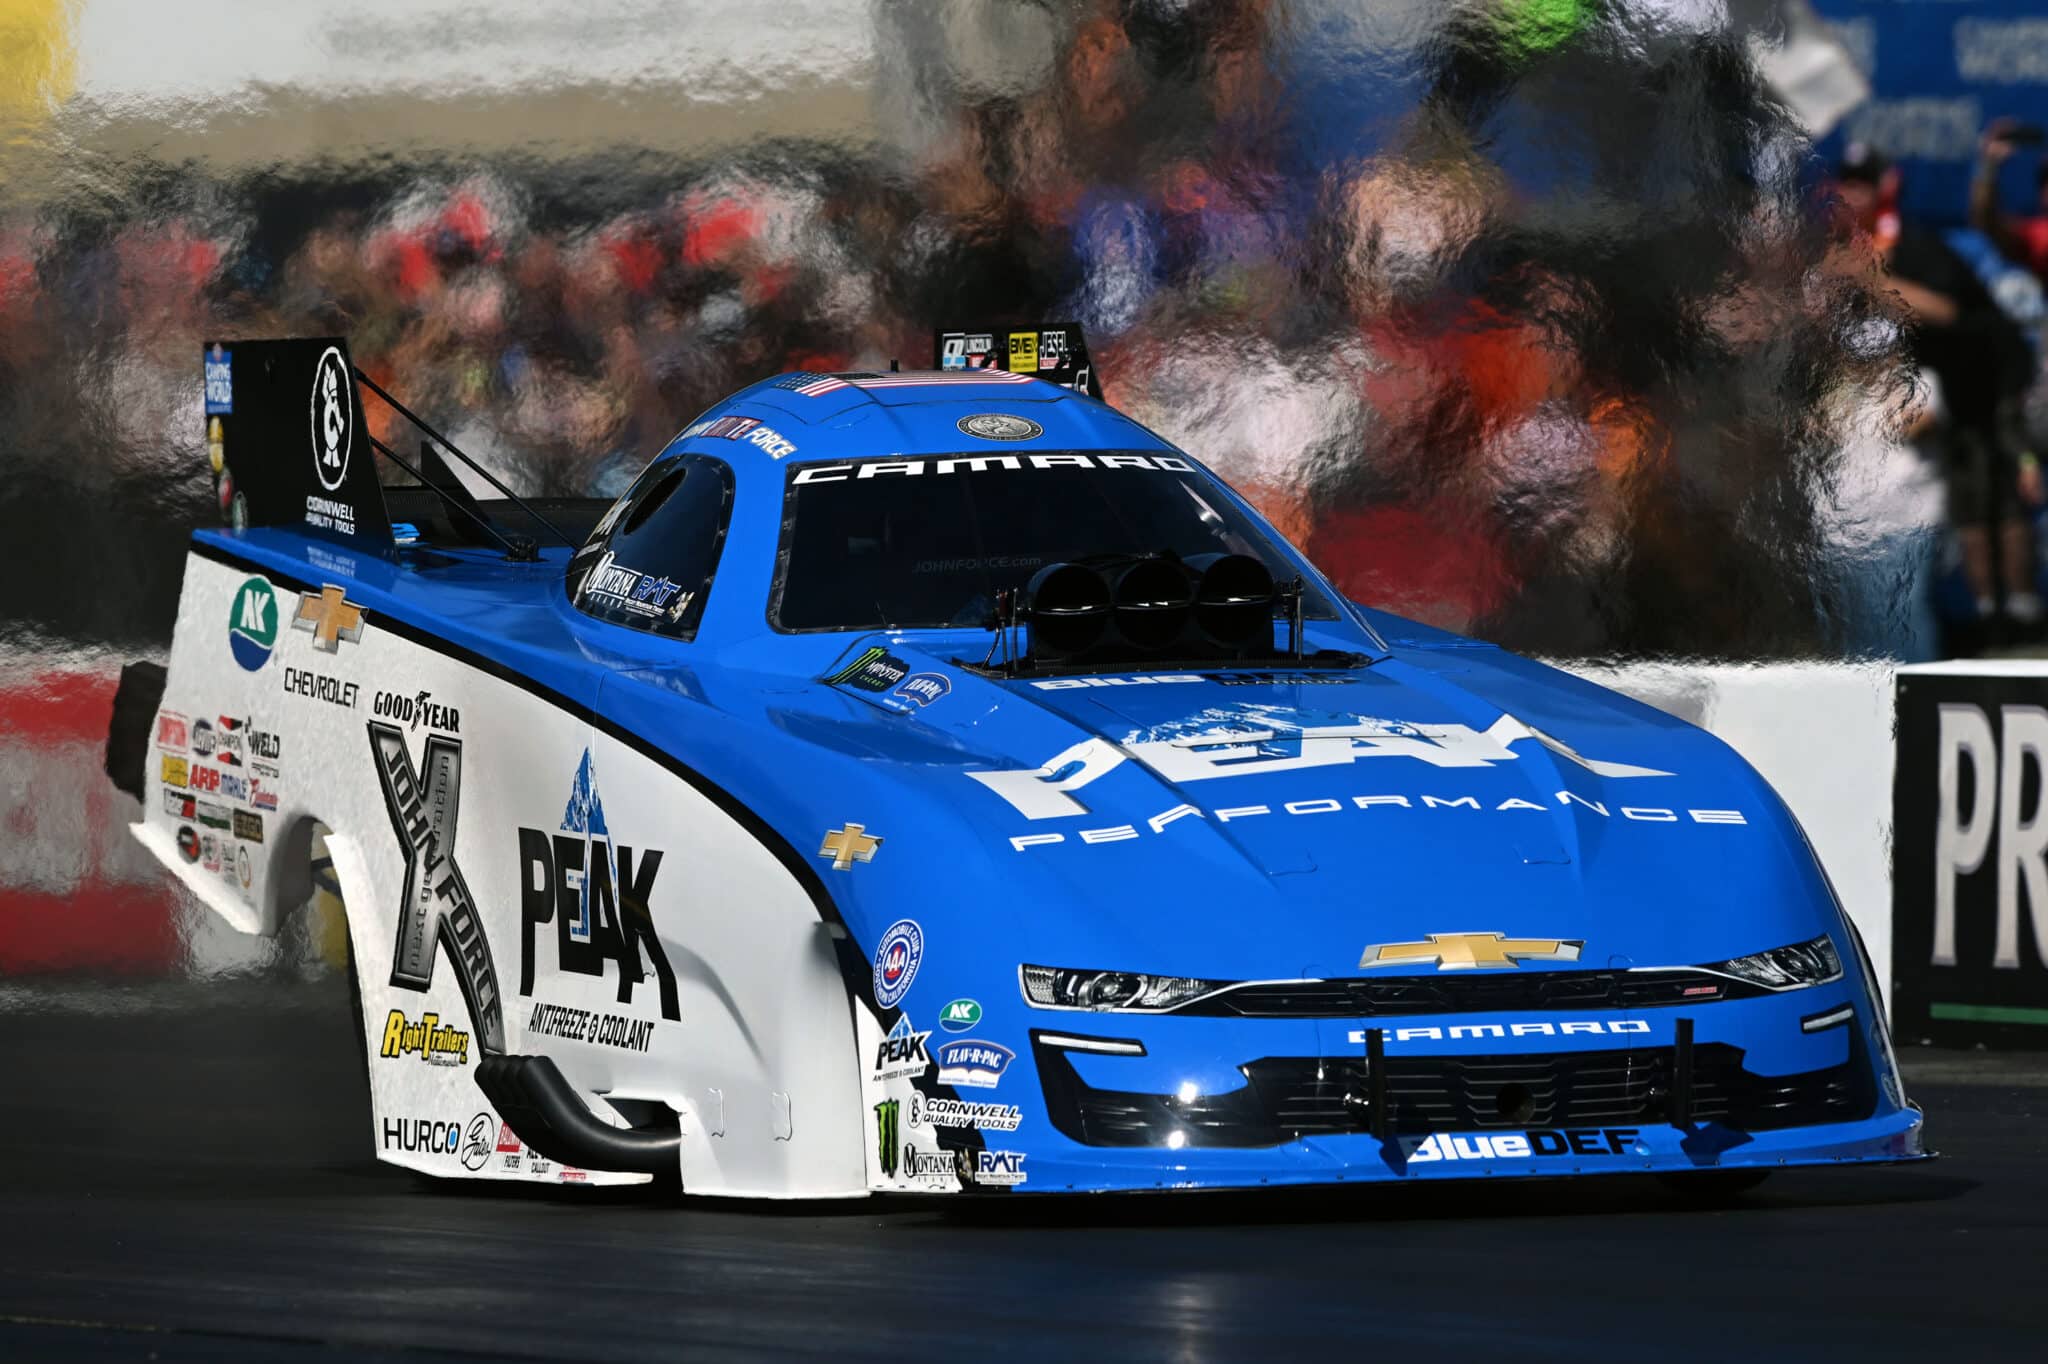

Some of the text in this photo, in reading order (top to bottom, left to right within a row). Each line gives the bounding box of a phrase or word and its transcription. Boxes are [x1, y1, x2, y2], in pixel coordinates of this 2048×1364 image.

[743, 427, 798, 460] FORCE
[792, 455, 1198, 485] CAMARO
[305, 511, 355, 535] QUALITY TOOLS
[306, 495, 355, 521] CORNWELL
[586, 551, 637, 598] MONTANA
[284, 667, 360, 709] CHEVROLET
[373, 691, 460, 732] GOODYEAR
[189, 763, 220, 791] ARP
[963, 713, 1678, 820] PEAK
[1009, 790, 1748, 852] PERFORMANCE
[385, 749, 444, 874] JOHN
[435, 873, 500, 1036] FORCE
[518, 826, 682, 1022] PEAK
[884, 950, 906, 973] AAA
[529, 1002, 591, 1041] ANTIFREEZE
[598, 1013, 655, 1053] COOLANT
[1348, 1020, 1651, 1044] CAMARO
[875, 1034, 926, 1070] PEAK
[923, 1113, 1018, 1130] QUALITY TOOLS
[926, 1100, 1018, 1119] CORNWELL
[384, 1117, 461, 1155] HURCO
[1400, 1129, 1639, 1164] BlueDEF
[904, 1143, 955, 1178] MONTANA
